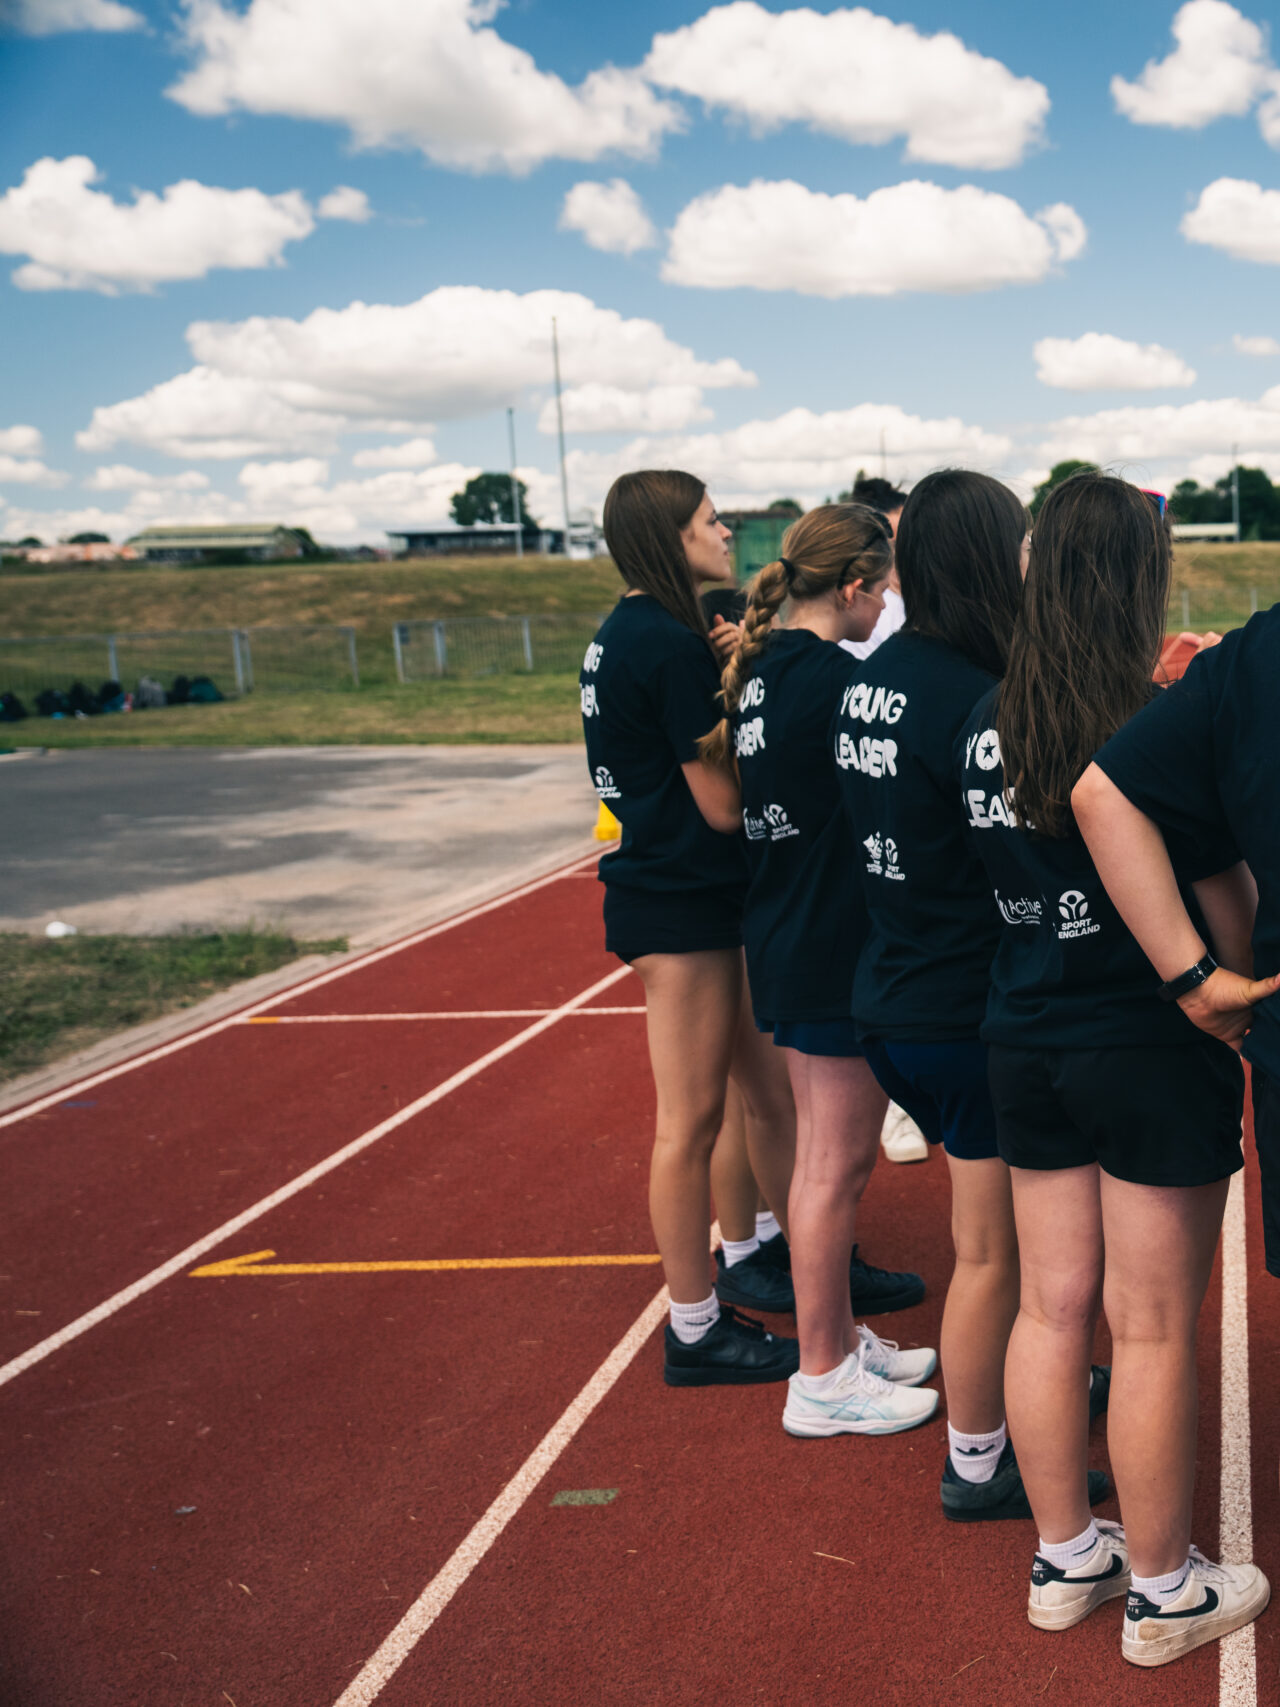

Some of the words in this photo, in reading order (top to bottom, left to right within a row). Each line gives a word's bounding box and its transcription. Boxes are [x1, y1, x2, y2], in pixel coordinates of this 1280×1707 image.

[841, 682, 907, 724] YOUNG
[1008, 897, 1042, 915] Active
[1058, 924, 1101, 939] ENGLAND
[1061, 918, 1092, 931] SPORT
